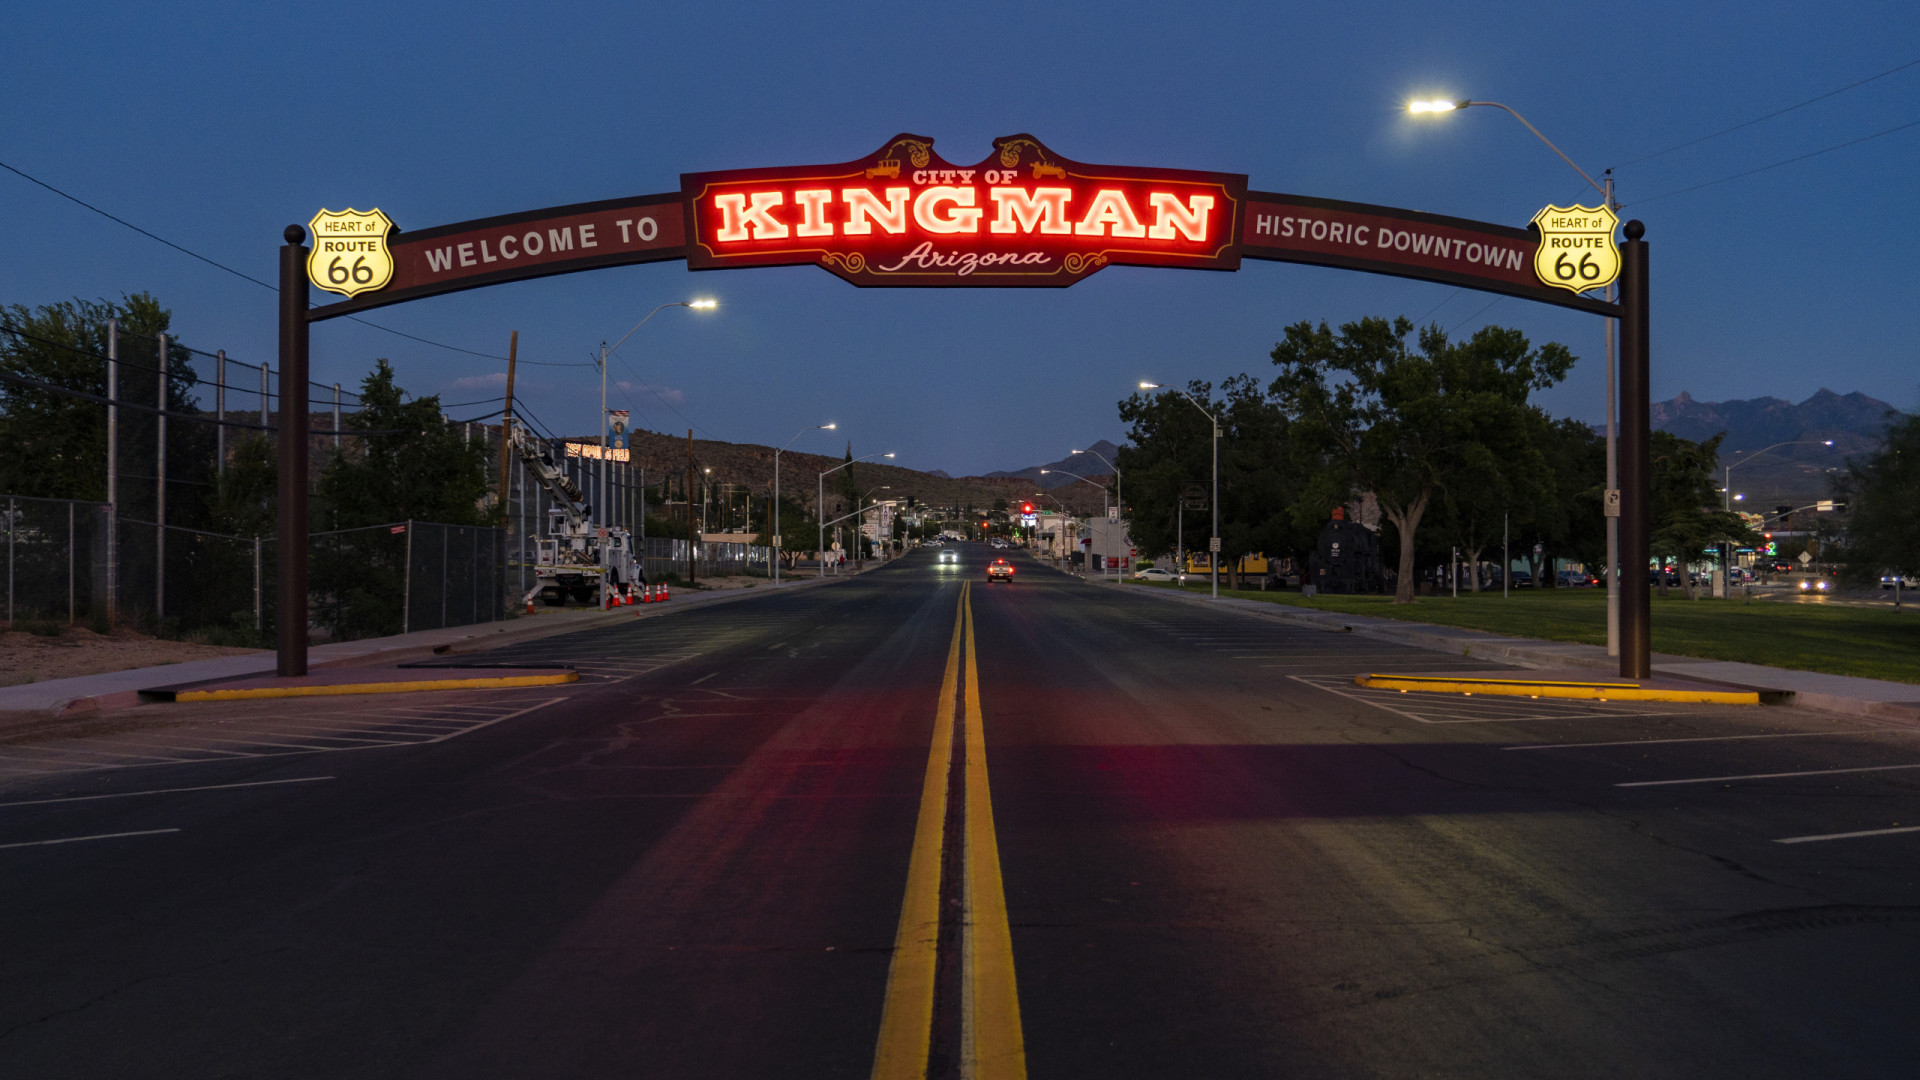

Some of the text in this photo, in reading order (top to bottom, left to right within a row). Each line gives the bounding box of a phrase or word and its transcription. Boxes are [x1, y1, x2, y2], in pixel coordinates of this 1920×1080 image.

[912, 169, 1018, 185] CITY OF
[325, 221, 376, 232] HEART of
[714, 186, 1214, 242] KINGMAN
[1551, 217, 1602, 229] HEART of
[324, 241, 377, 252] ROUTE
[424, 216, 659, 273] WELCOME TO
[1255, 213, 1523, 272] HISTORIC DOWNTOWN
[1550, 237, 1604, 249] ROUTE
[328, 255, 374, 285] 66
[878, 241, 1051, 276] Arizona
[1554, 251, 1600, 281] 66
